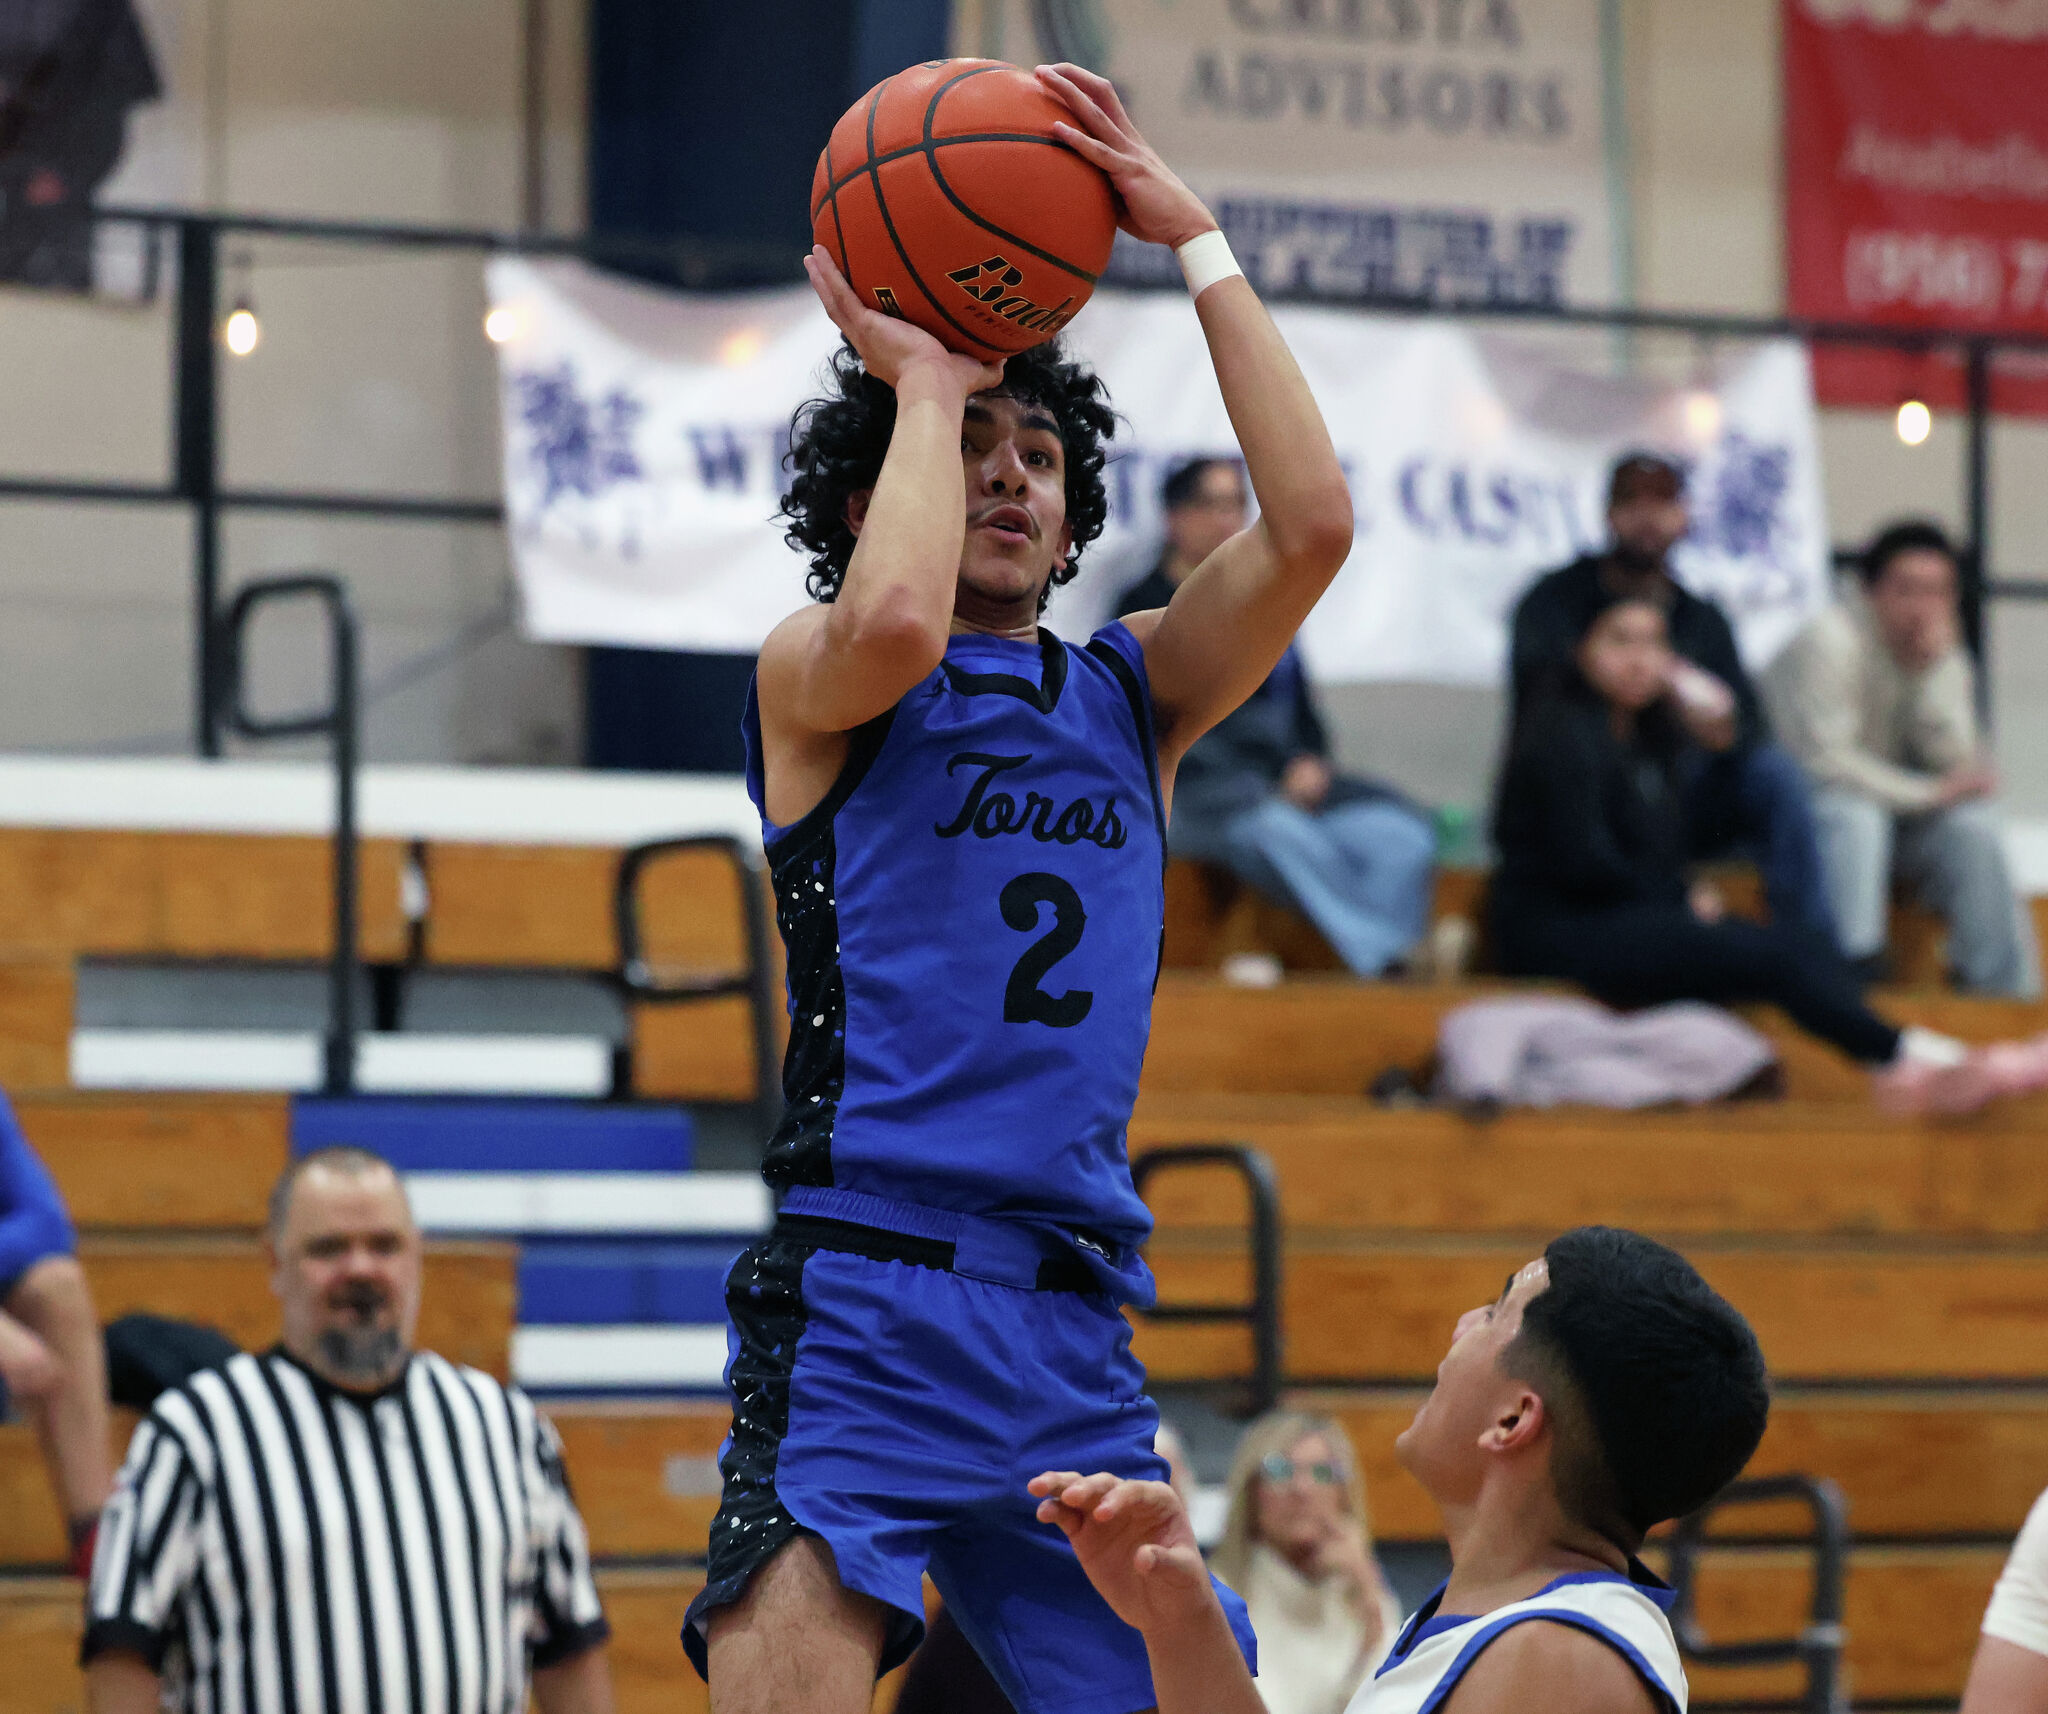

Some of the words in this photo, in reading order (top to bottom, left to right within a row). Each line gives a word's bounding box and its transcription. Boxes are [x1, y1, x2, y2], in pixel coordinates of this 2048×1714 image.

[1187, 48, 1570, 139] ADVISORS
[934, 752, 1127, 849] Toros
[999, 872, 1093, 1027] 2
